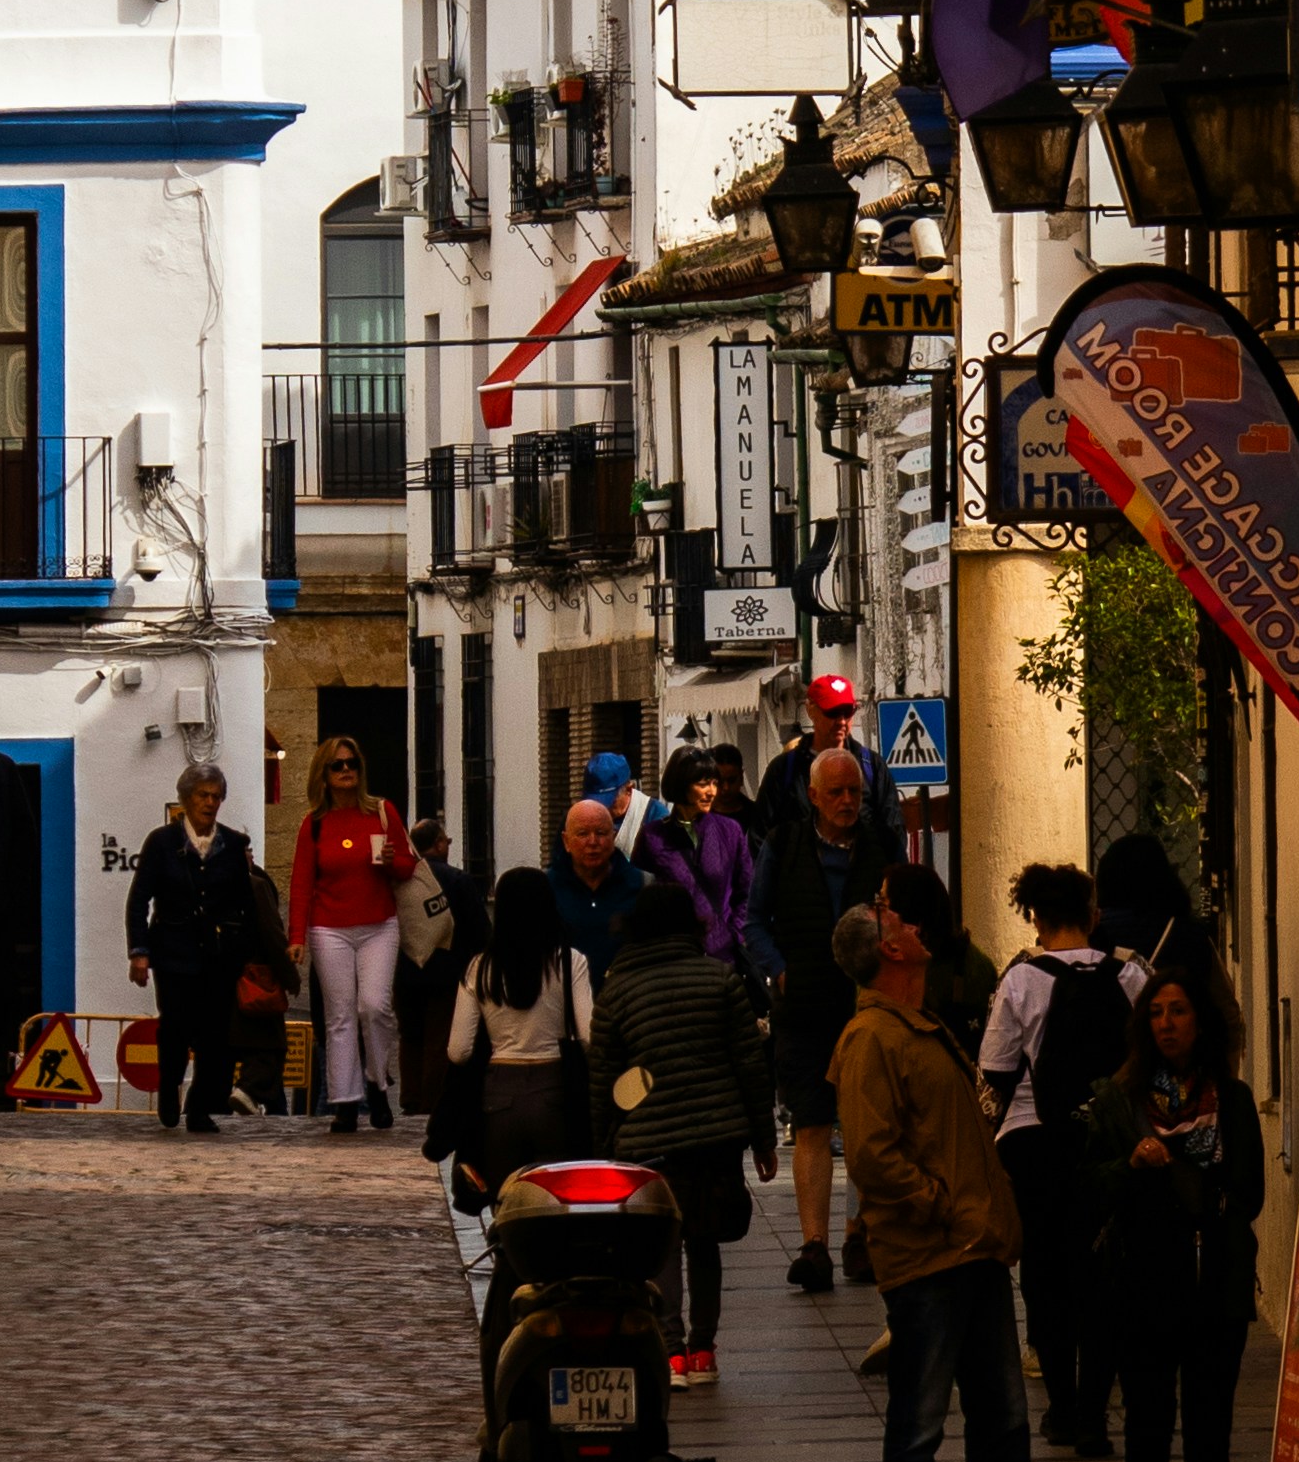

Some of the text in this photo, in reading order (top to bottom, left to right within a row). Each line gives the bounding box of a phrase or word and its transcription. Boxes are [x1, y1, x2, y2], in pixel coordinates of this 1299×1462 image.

[858, 294, 952, 327] ATM
[714, 626, 786, 638] Taberna
[101, 833, 117, 848] la
[571, 1370, 629, 1393] 8044
[578, 1398, 628, 1420] HMJ
